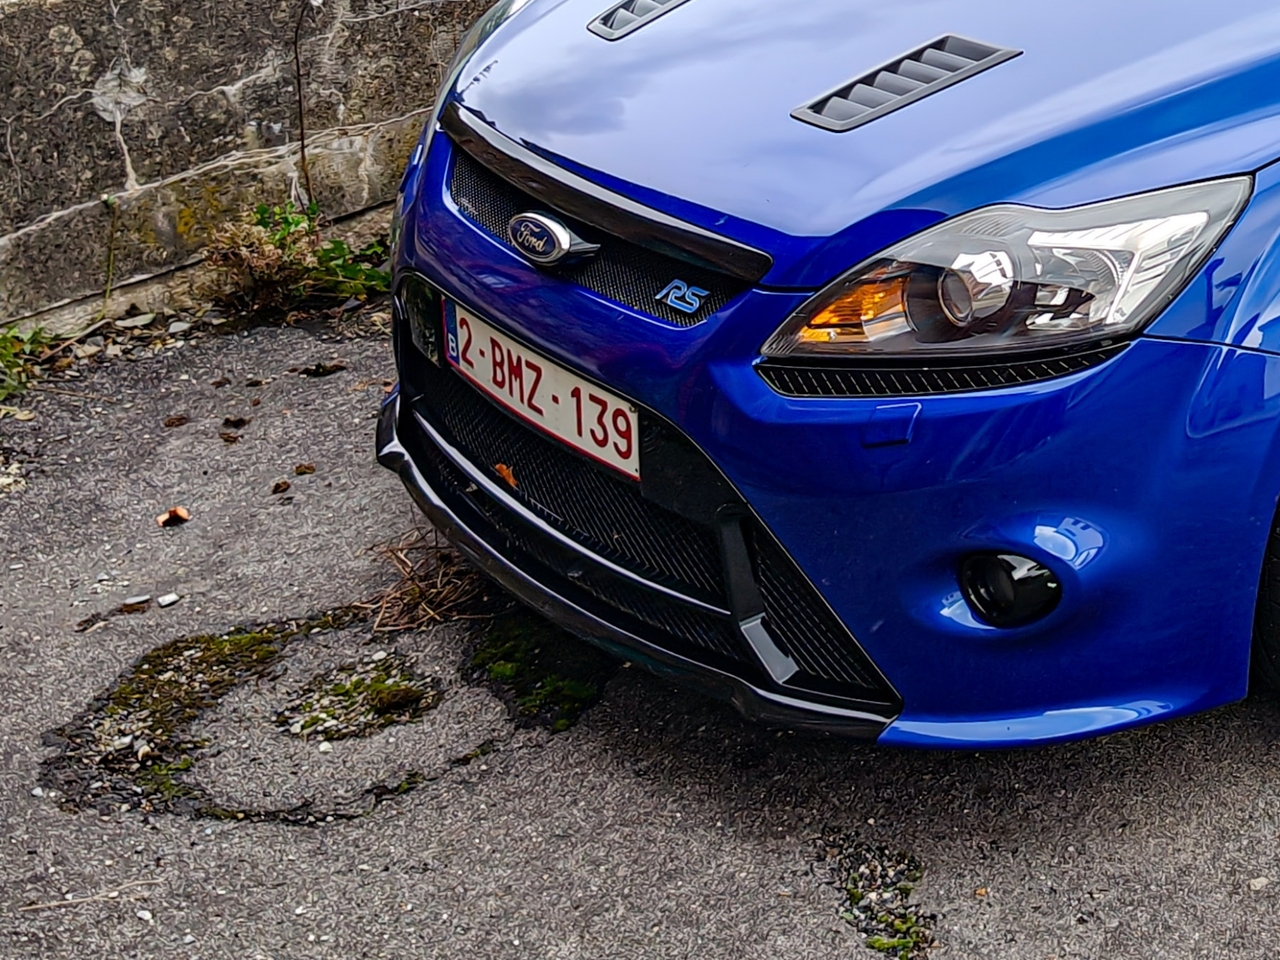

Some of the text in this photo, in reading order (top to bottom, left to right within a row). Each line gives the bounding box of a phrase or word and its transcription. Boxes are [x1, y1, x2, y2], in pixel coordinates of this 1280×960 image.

[517, 222, 547, 254] Ford
[654, 278, 711, 313] RS
[448, 317, 633, 460] B 2-BMZ-139
